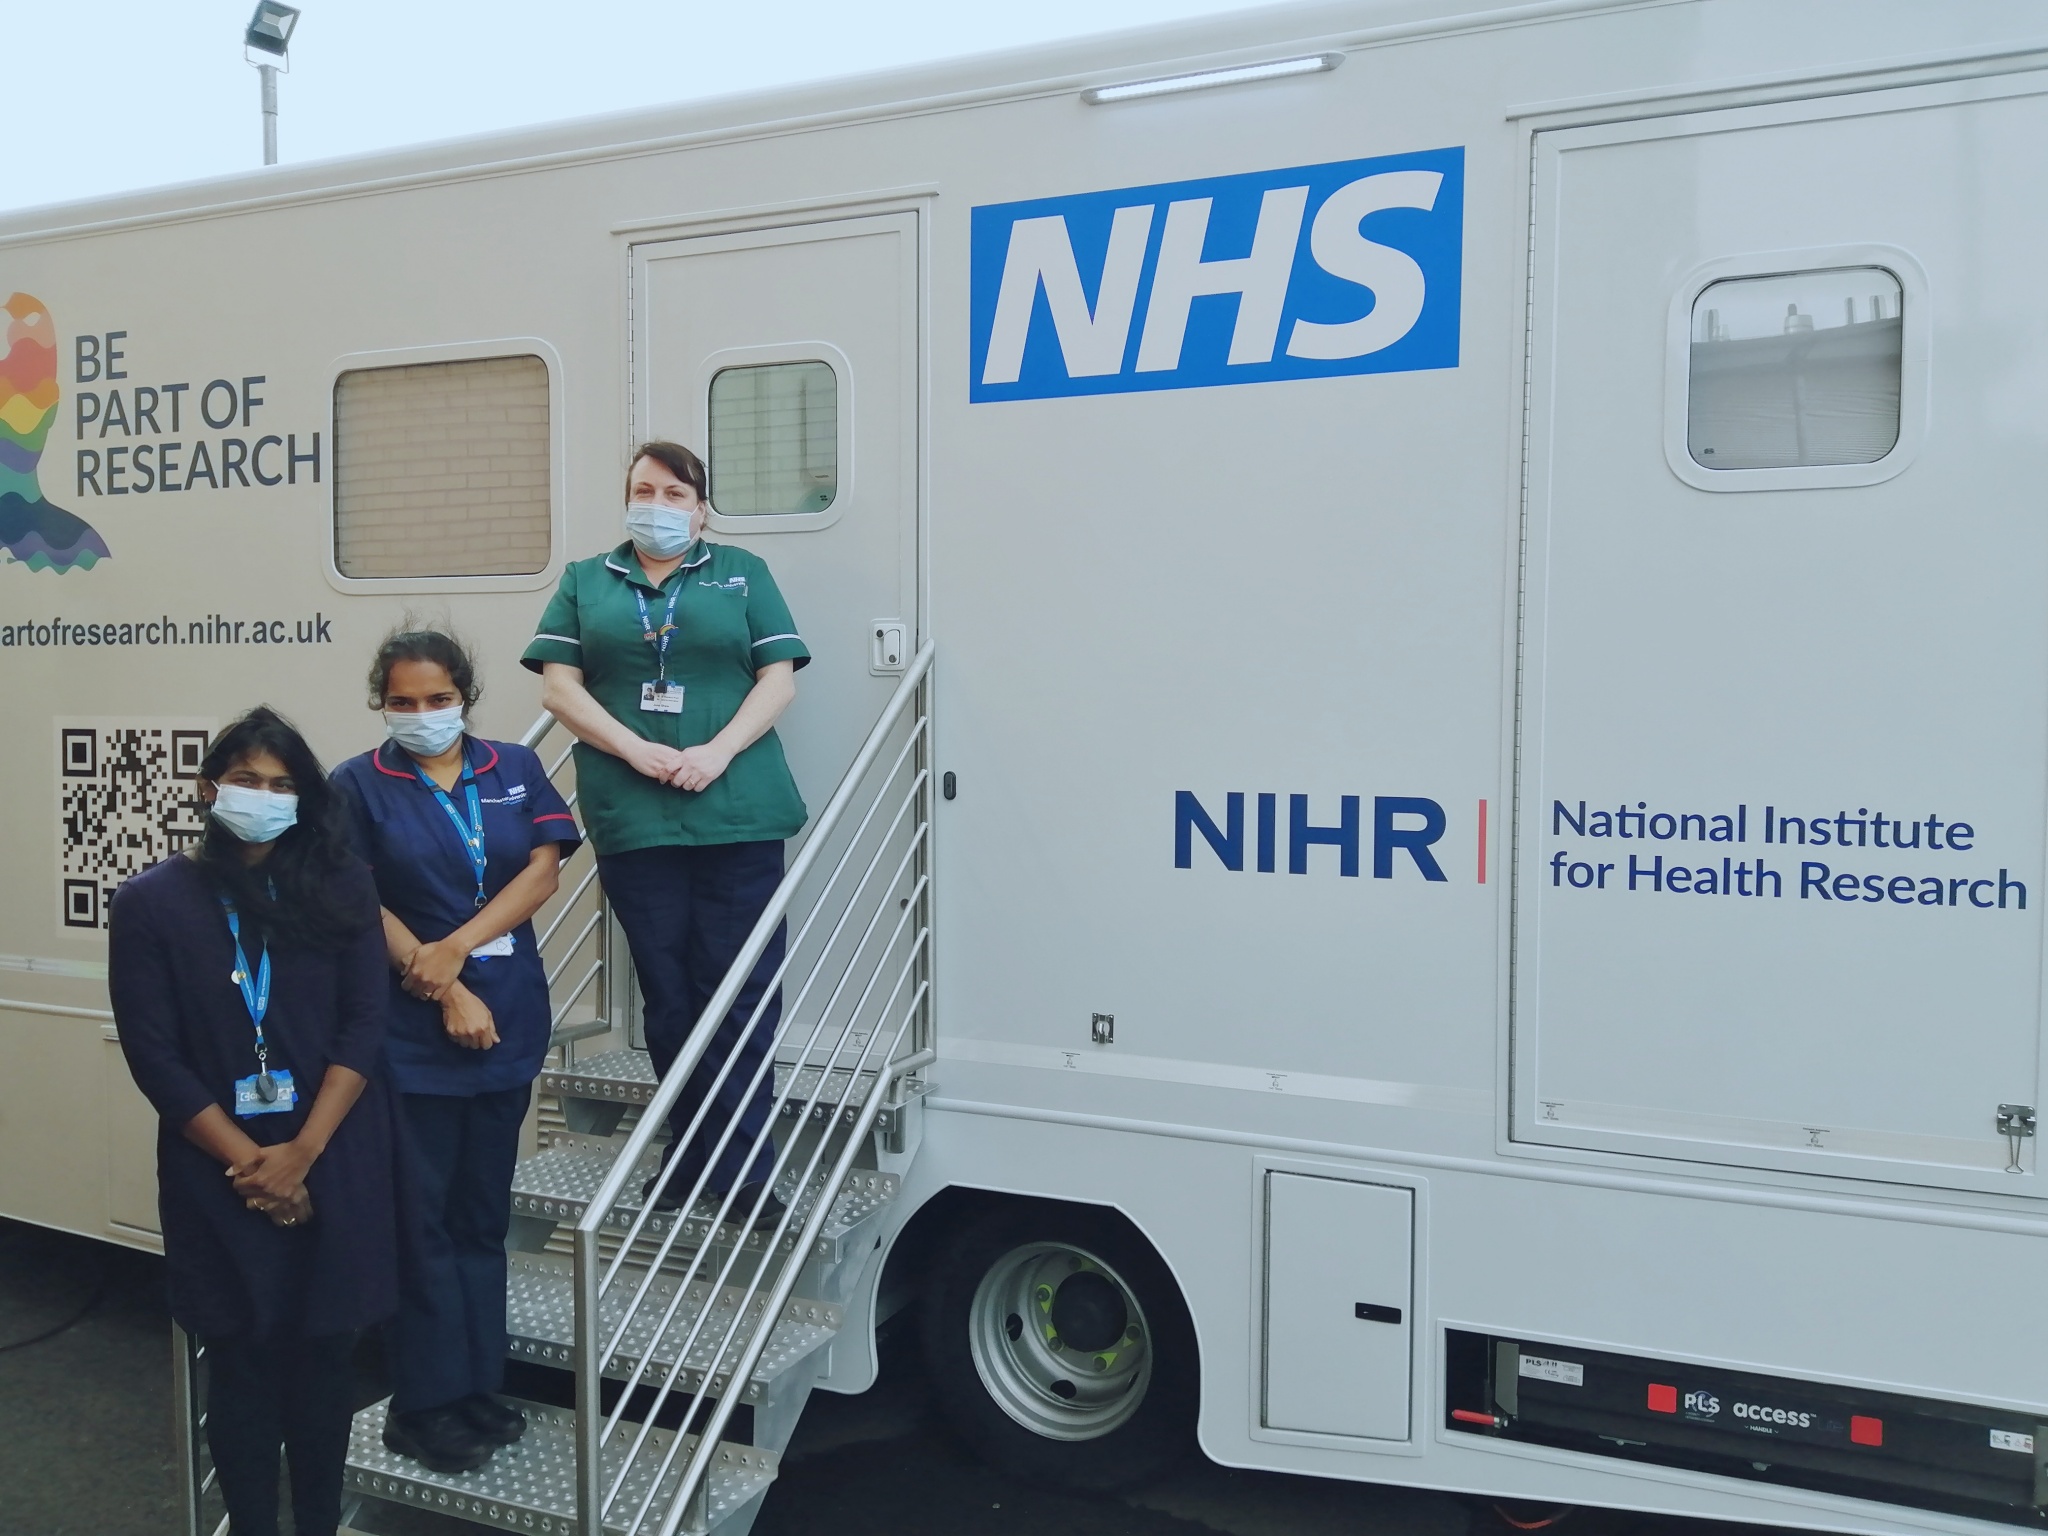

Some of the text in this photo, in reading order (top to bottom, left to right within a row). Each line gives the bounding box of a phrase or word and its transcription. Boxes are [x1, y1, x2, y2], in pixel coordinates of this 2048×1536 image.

[981, 169, 1445, 386] NHS
[75, 330, 128, 384] BE
[76, 375, 266, 441] PART OF
[76, 431, 321, 497] RESEARCH
[1, 612, 332, 647] artofresearch.nihr.ac.uk
[1174, 790, 1449, 883] NIHR
[1553, 799, 1975, 851] National Institute
[1549, 850, 2027, 910] for Health Research
[1684, 1393, 1721, 1414] PLS
[1733, 1401, 1811, 1428] access
